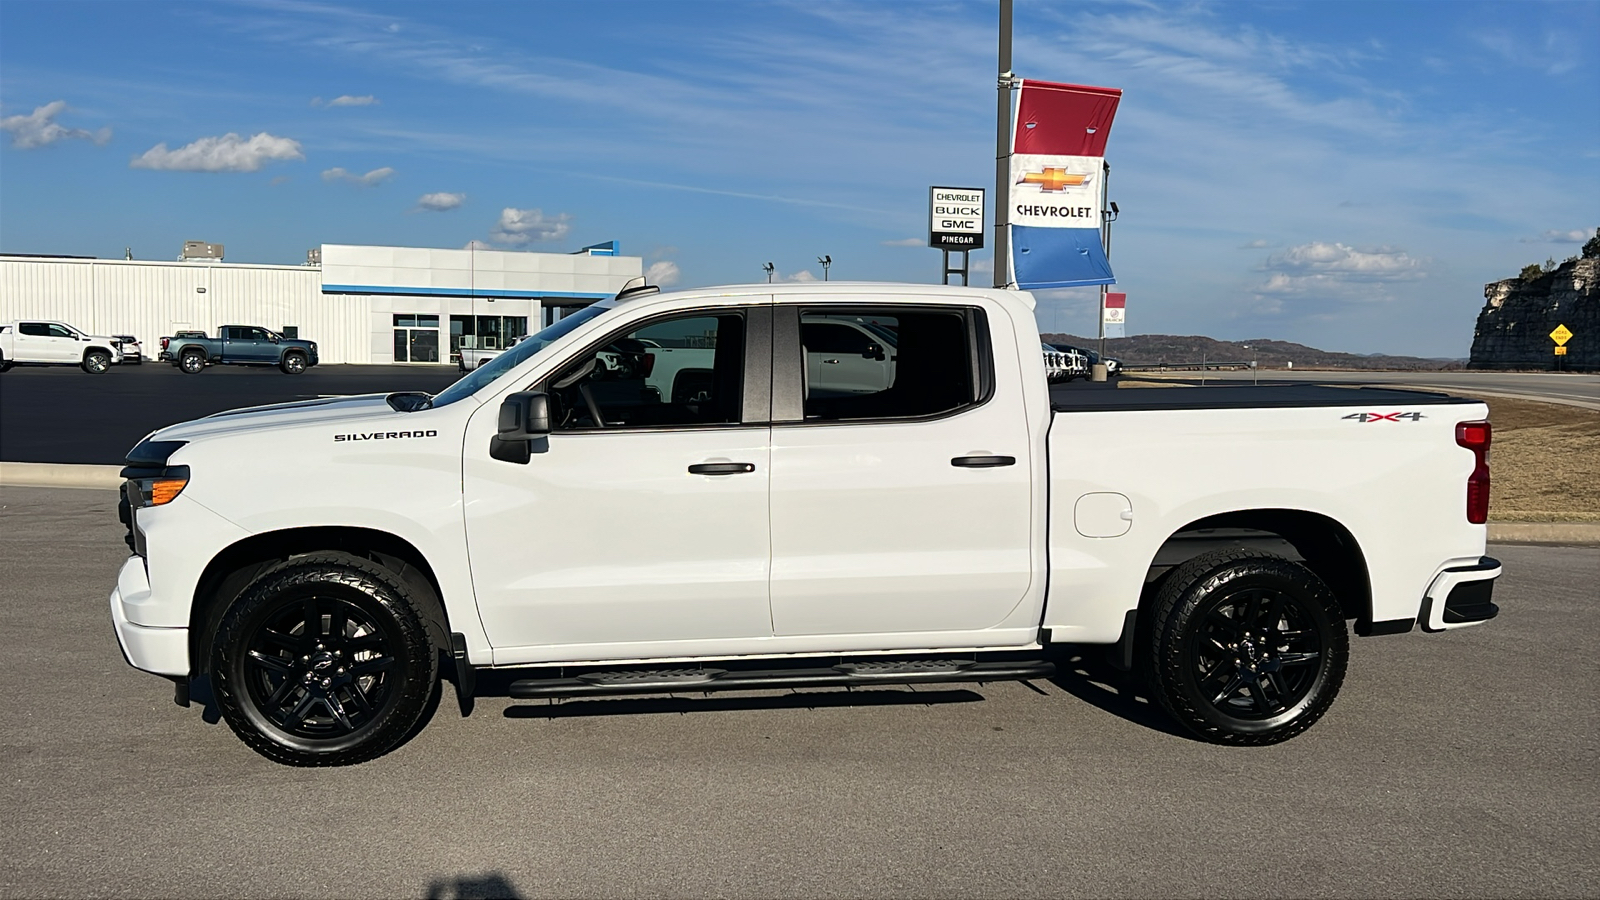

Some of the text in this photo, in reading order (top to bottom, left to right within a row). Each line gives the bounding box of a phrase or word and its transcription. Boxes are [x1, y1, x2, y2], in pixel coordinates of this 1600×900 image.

[936, 193, 980, 202] CHEVROLET
[935, 206, 980, 216] BUICK
[1016, 204, 1092, 218] CHEVROLET
[941, 220, 974, 229] GMC
[941, 235, 974, 244] PINEGAR
[334, 430, 437, 442] SILVERADO
